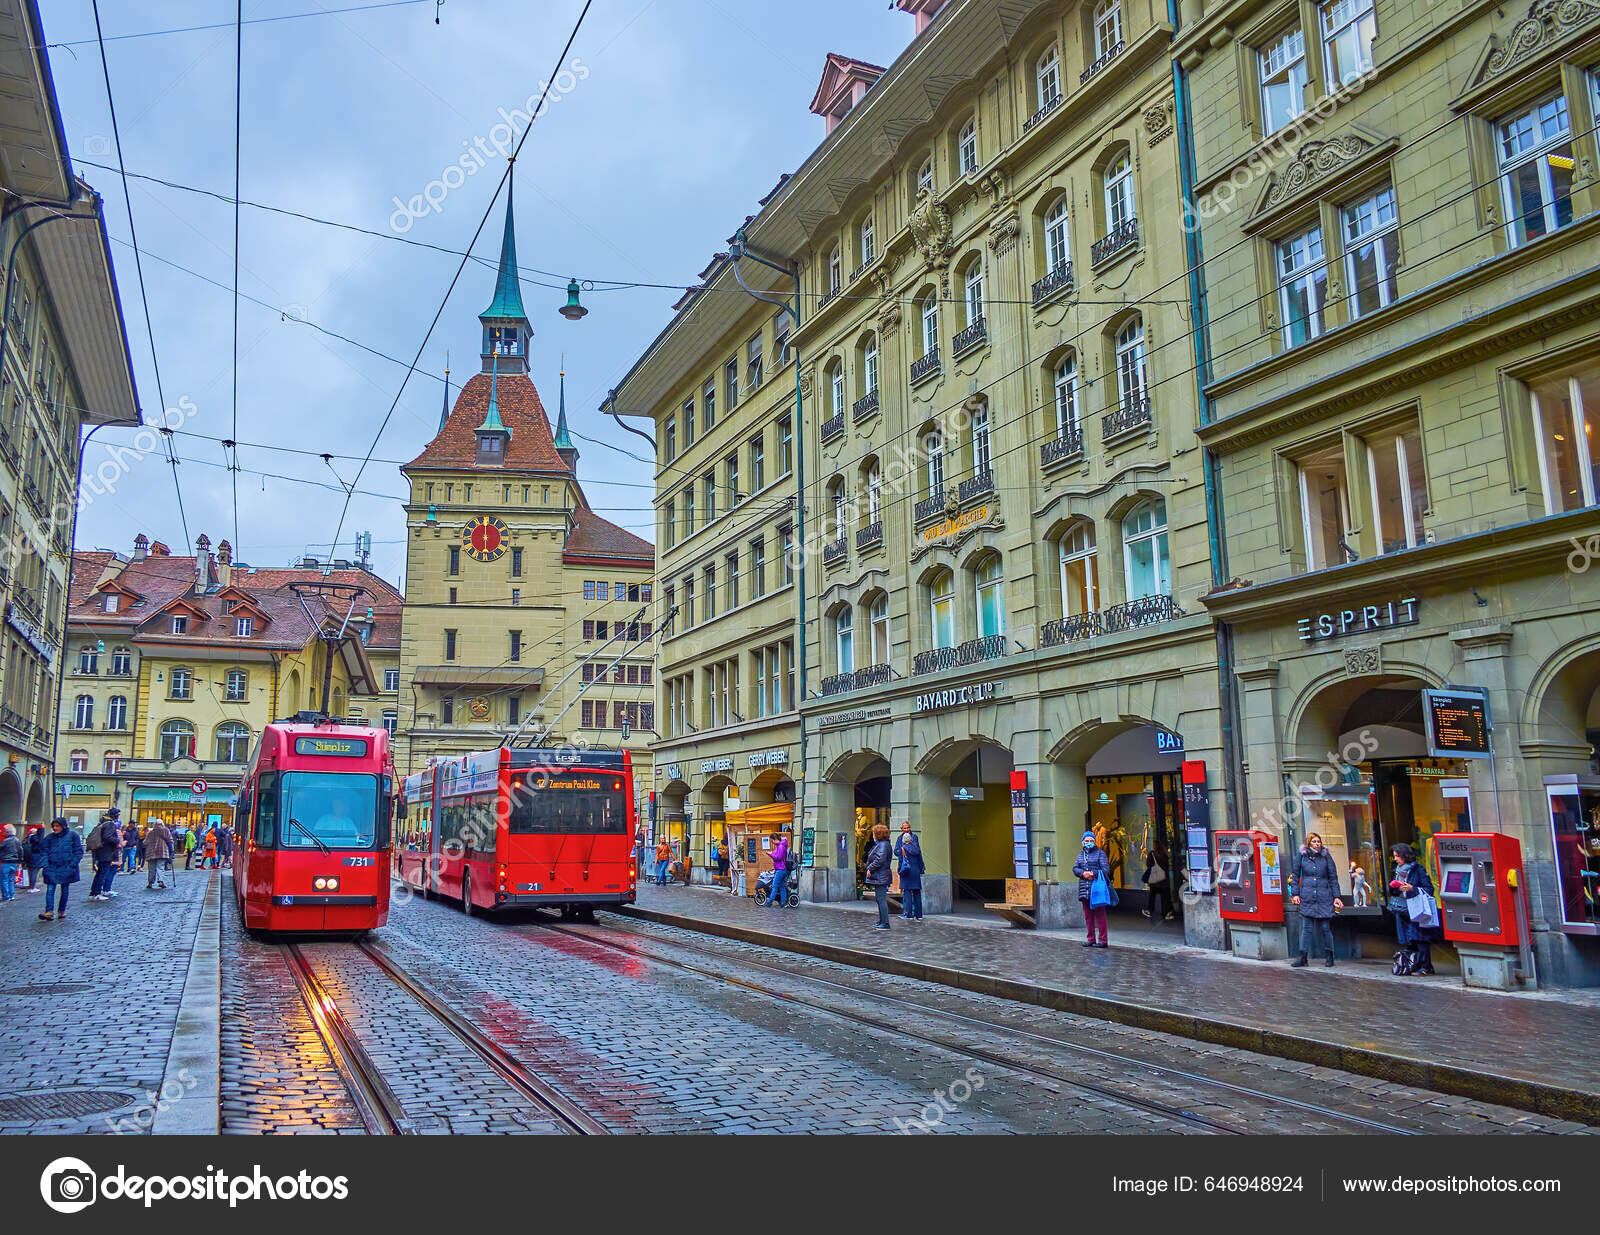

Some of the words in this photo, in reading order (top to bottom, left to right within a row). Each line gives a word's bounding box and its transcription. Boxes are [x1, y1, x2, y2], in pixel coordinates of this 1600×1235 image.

[1297, 597, 1416, 640] ESPRIT
[916, 689, 957, 711] BAYARD
[748, 753, 766, 767] GERRY
[766, 750, 786, 765] WEBER
[573, 779, 586, 789] Paul
[1440, 841, 1468, 852] Tickets
[350, 857, 368, 867] 731
[527, 882, 538, 891] 21
